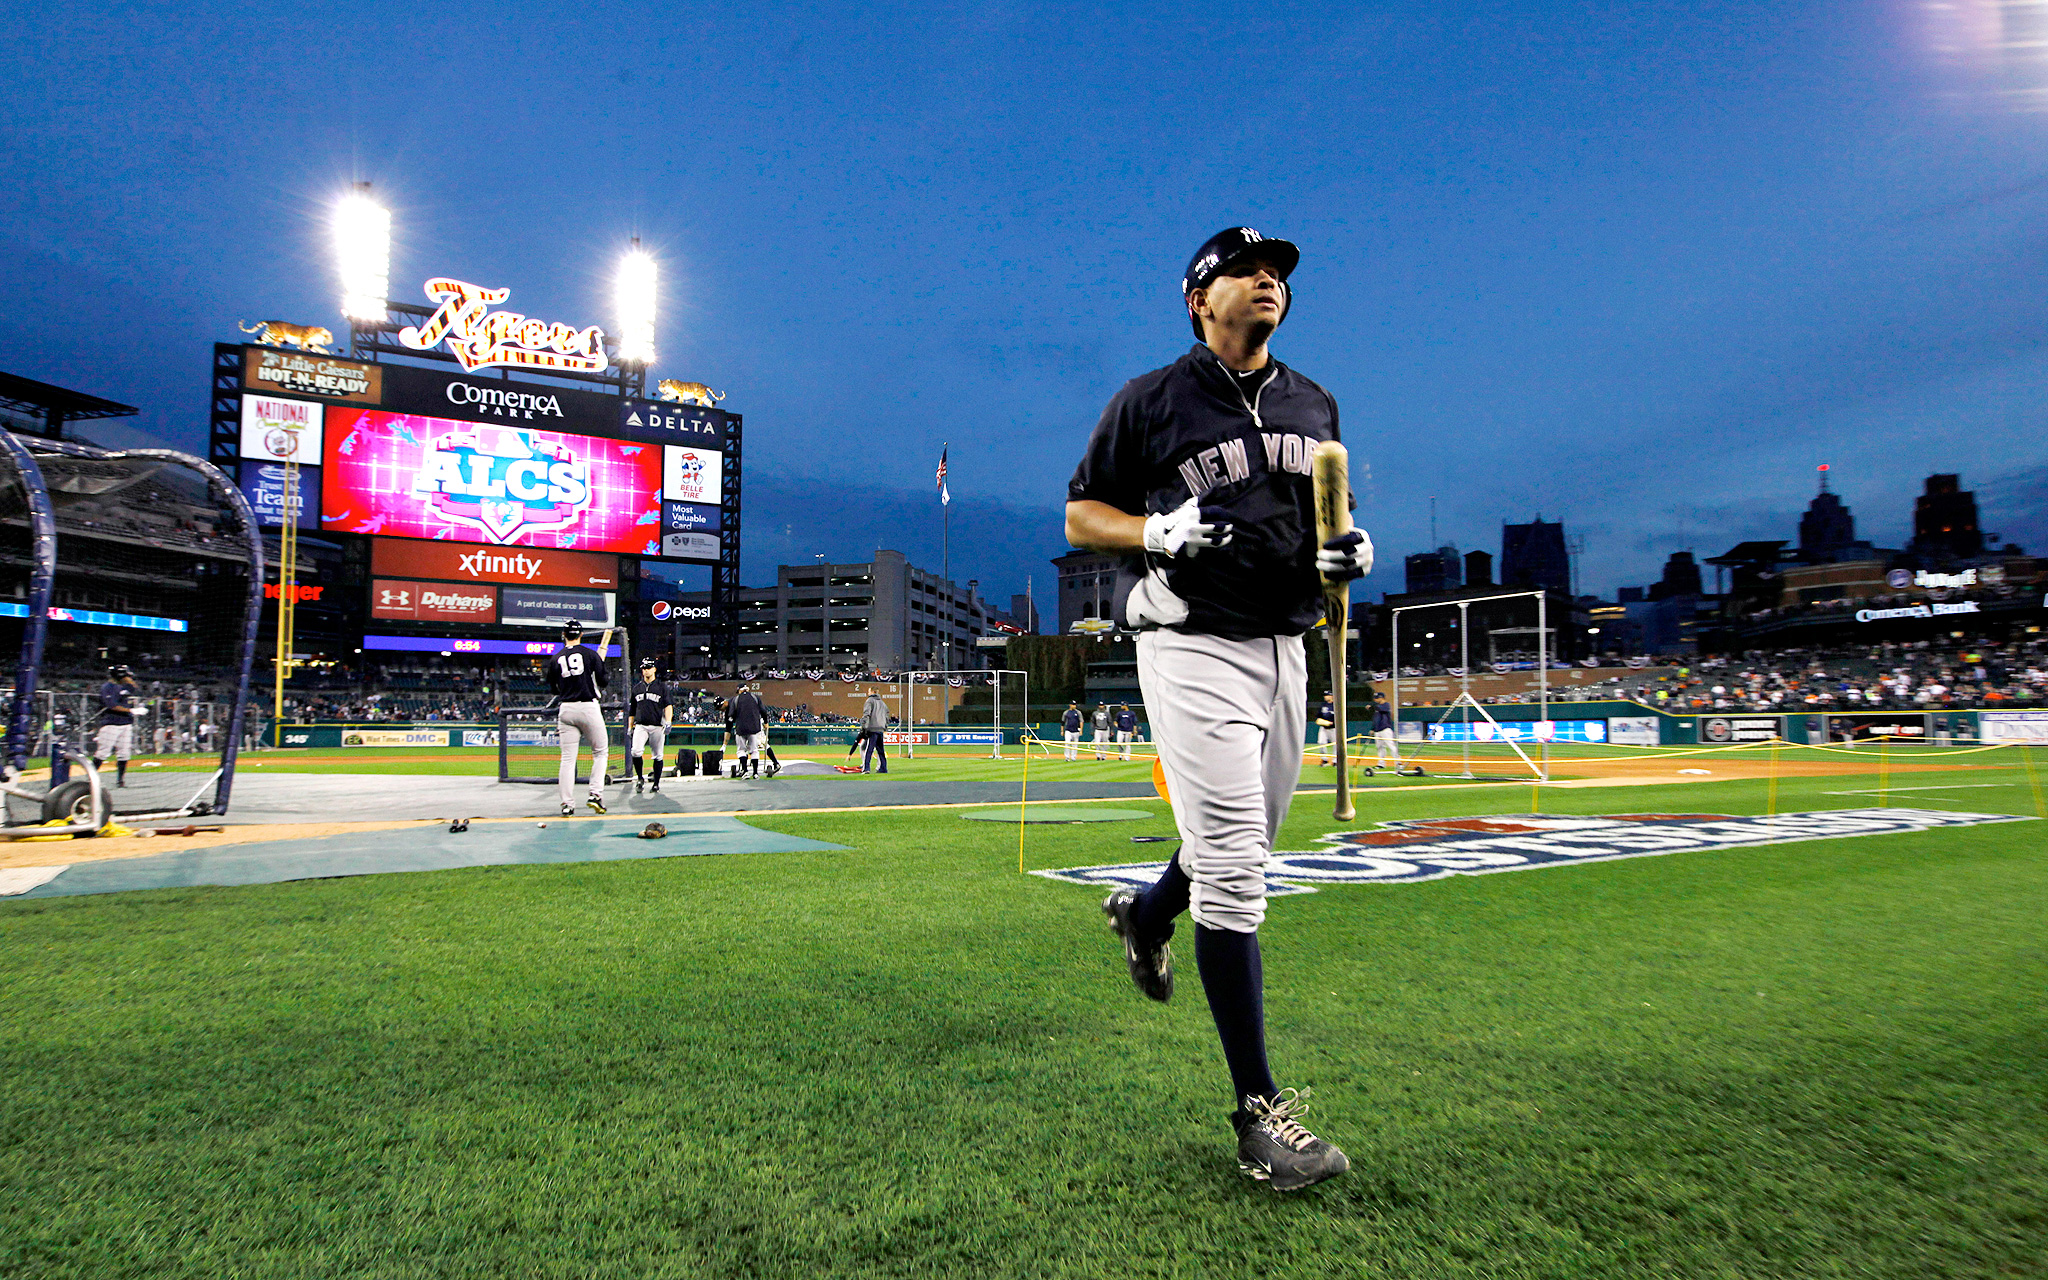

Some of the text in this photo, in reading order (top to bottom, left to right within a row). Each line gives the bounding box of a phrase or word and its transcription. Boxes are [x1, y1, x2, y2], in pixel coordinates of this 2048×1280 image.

[399, 277, 608, 373] Tigers
[281, 356, 365, 380] Little Caesars
[258, 366, 370, 394] HOT-N-READY
[256, 400, 309, 424] NATIONAL
[478, 404, 534, 420] PARK
[649, 414, 716, 435] DELTA
[1178, 432, 1320, 497] NEW YOR
[416, 452, 587, 504] ALCS
[680, 484, 704, 493] BELLE
[683, 491, 700, 499] TIRE
[252, 488, 304, 507] Team
[672, 504, 694, 514] Most
[672, 512, 707, 524] Valuable
[672, 521, 692, 530] Card
[458, 550, 543, 580] xfinity
[421, 591, 494, 608] Dunham's
[523, 601, 536, 609] part
[536, 600, 543, 608] of
[543, 601, 562, 609] Detroit
[562, 602, 577, 610] since
[673, 606, 711, 619] pepsi
[454, 640, 480, 651] 6:54
[557, 653, 585, 678] 19
[820, 682, 825, 690] 5
